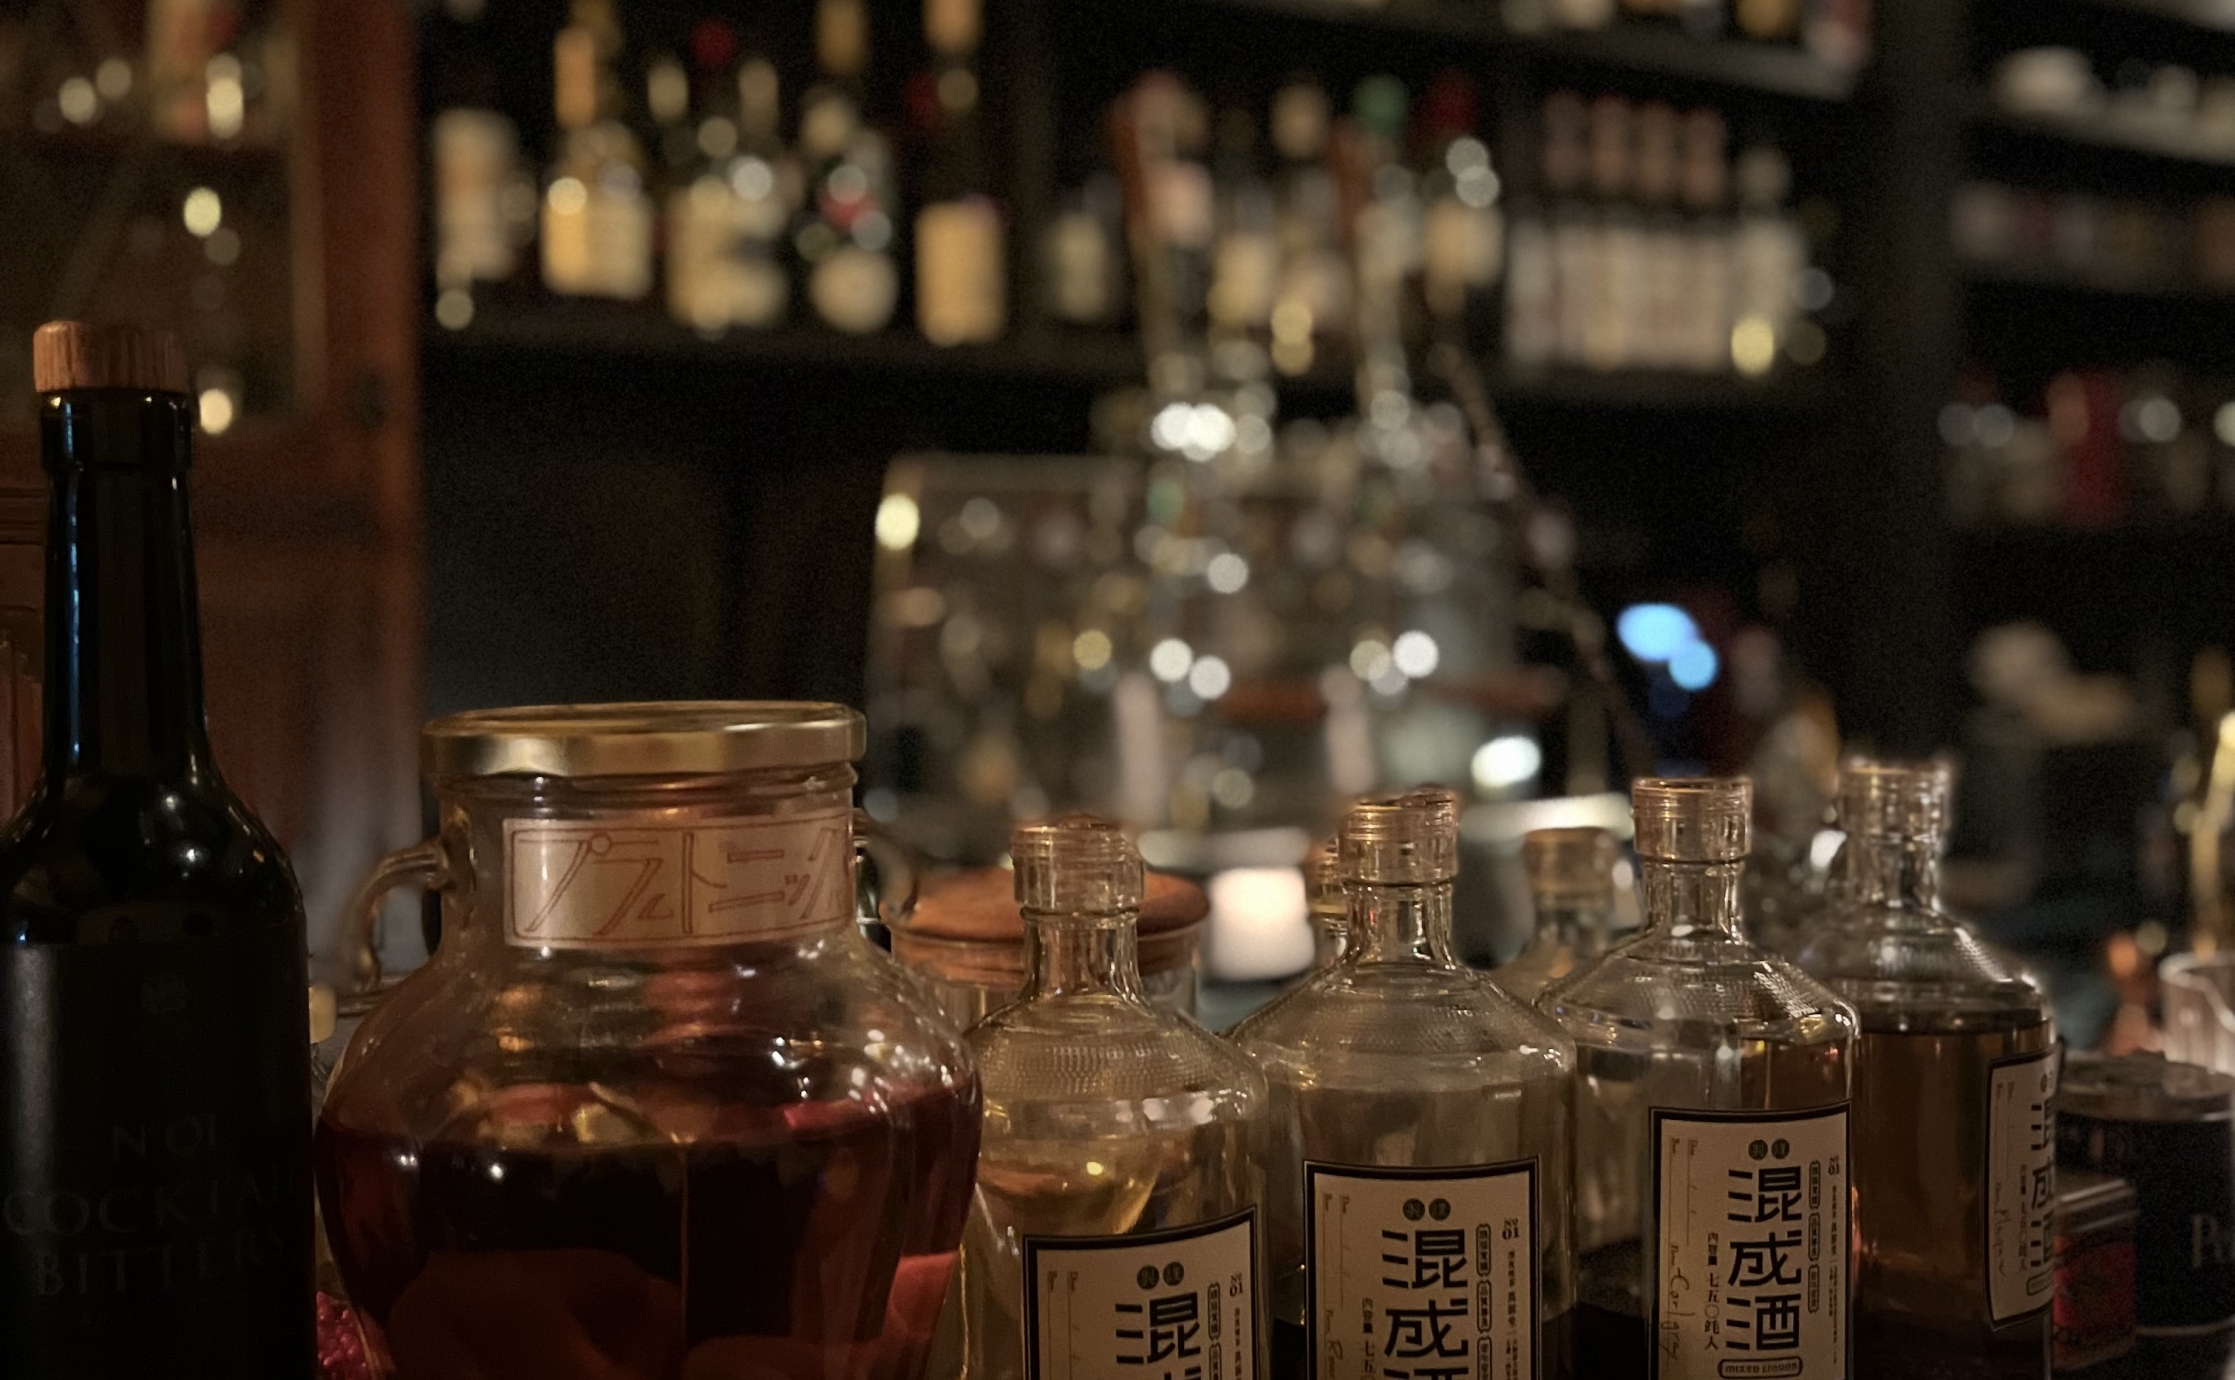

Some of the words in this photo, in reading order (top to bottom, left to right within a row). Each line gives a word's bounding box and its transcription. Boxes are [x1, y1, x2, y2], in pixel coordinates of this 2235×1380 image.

[1381, 1228, 1469, 1380] 混成
[1726, 1166, 1803, 1351] 混成酒
[1725, 1365, 1760, 1374] MIXED
